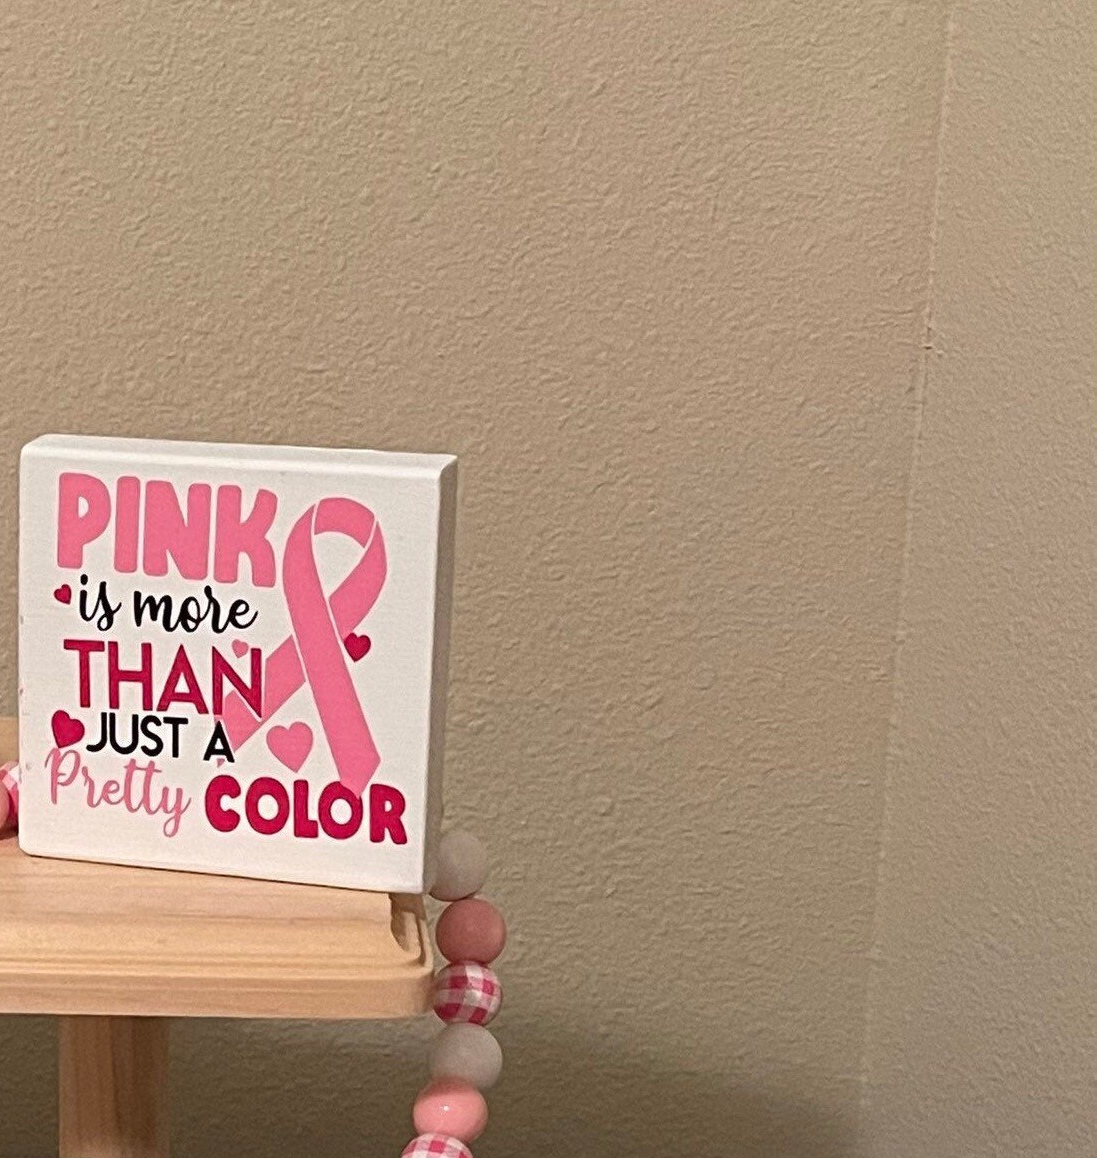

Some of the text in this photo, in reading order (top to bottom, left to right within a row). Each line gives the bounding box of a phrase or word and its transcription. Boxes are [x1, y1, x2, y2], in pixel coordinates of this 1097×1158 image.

[57, 472, 278, 587] PINK
[79, 574, 258, 633] is more
[64, 639, 262, 718] THAN
[86, 712, 234, 763] JUST A
[44, 747, 407, 845] Pretty COLOR
